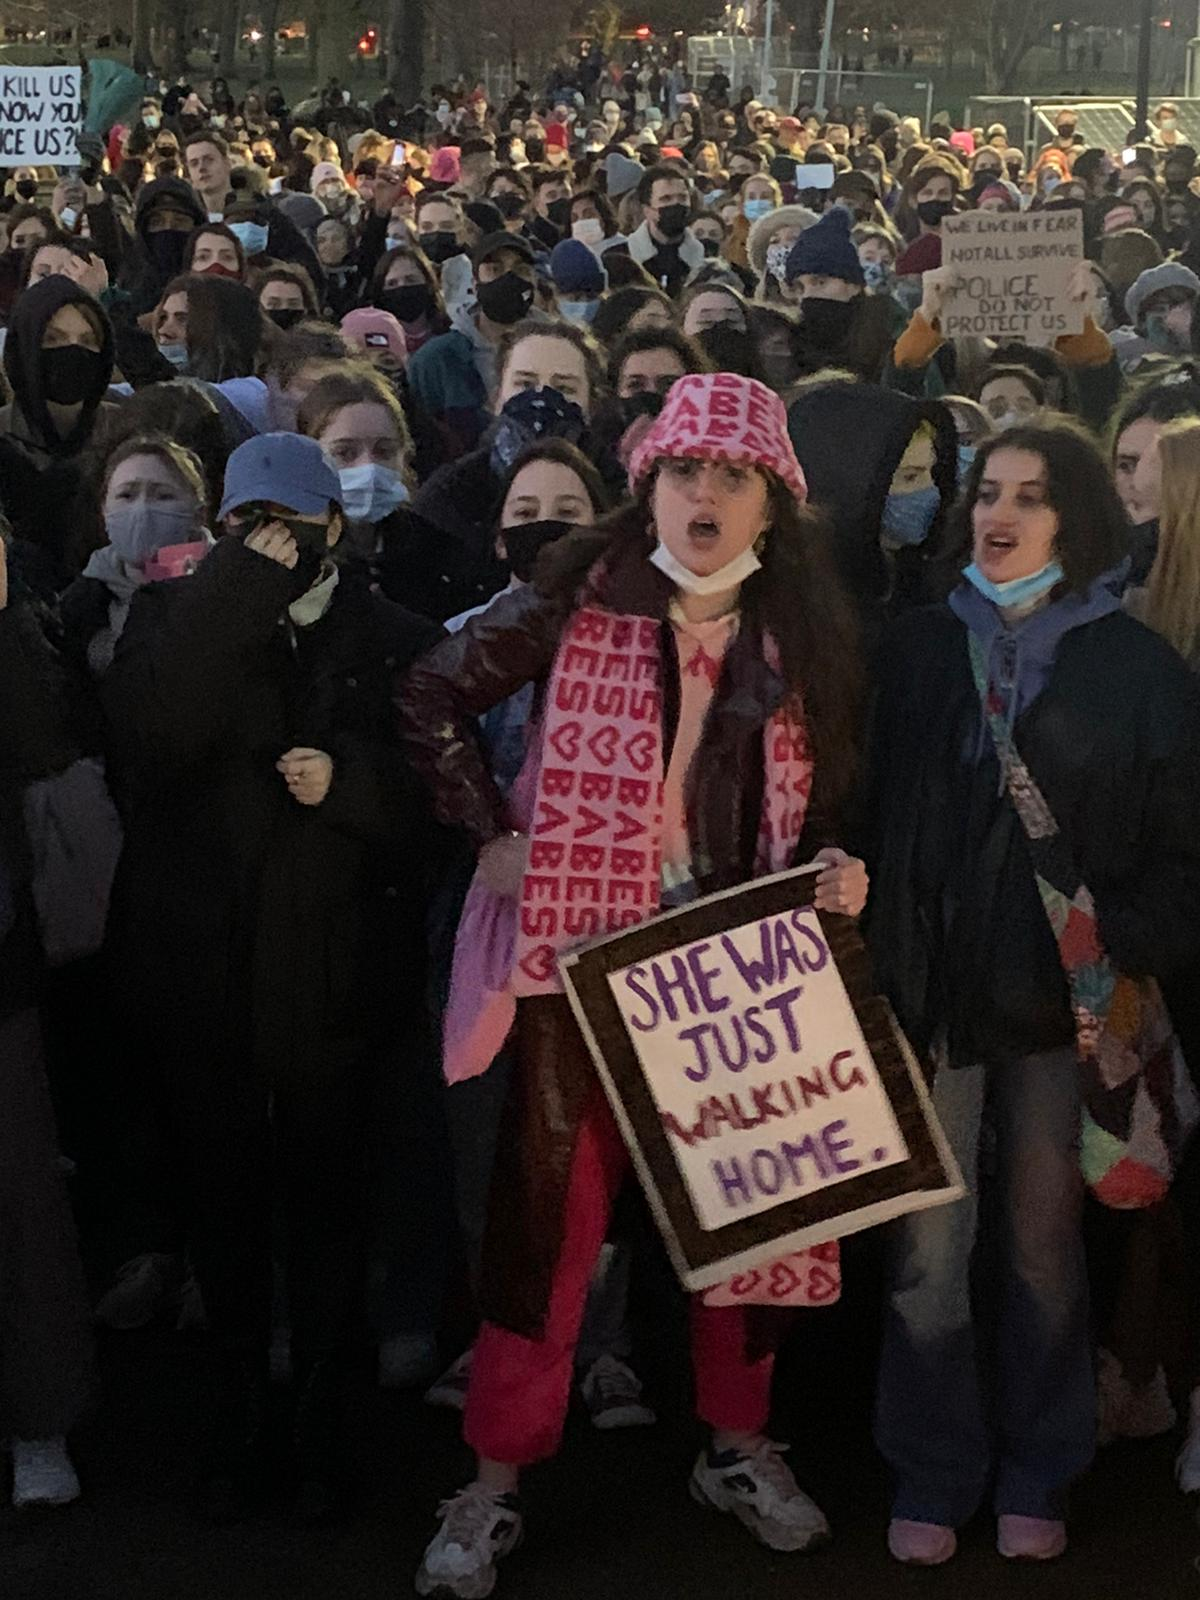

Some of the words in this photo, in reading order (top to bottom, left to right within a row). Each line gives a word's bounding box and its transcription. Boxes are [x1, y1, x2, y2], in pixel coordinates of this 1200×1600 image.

[3, 75, 41, 97] KILL
[49, 74, 76, 98] US
[51, 102, 80, 123] YOU
[946, 220, 970, 233] WE
[977, 219, 1009, 233] LIVE
[1012, 220, 1028, 232] IN
[1033, 216, 1078, 232] FEAR
[951, 248, 981, 262] NOT
[981, 247, 1013, 261] ALL
[1016, 244, 1079, 260] SURVIVE
[955, 275, 1038, 299] POLICE
[979, 300, 1007, 314] DO
[1014, 297, 1055, 312] NOT
[946, 315, 1033, 334] PROTECT
[1041, 314, 1067, 330] US
[520, 767, 576, 938] BABES
[563, 771, 614, 937] BABES
[625, 941, 730, 1033] SHE
[721, 905, 829, 993] WAS
[677, 986, 805, 1083] JUST
[658, 1050, 869, 1148] WALKING
[711, 1119, 888, 1208] HOME.
